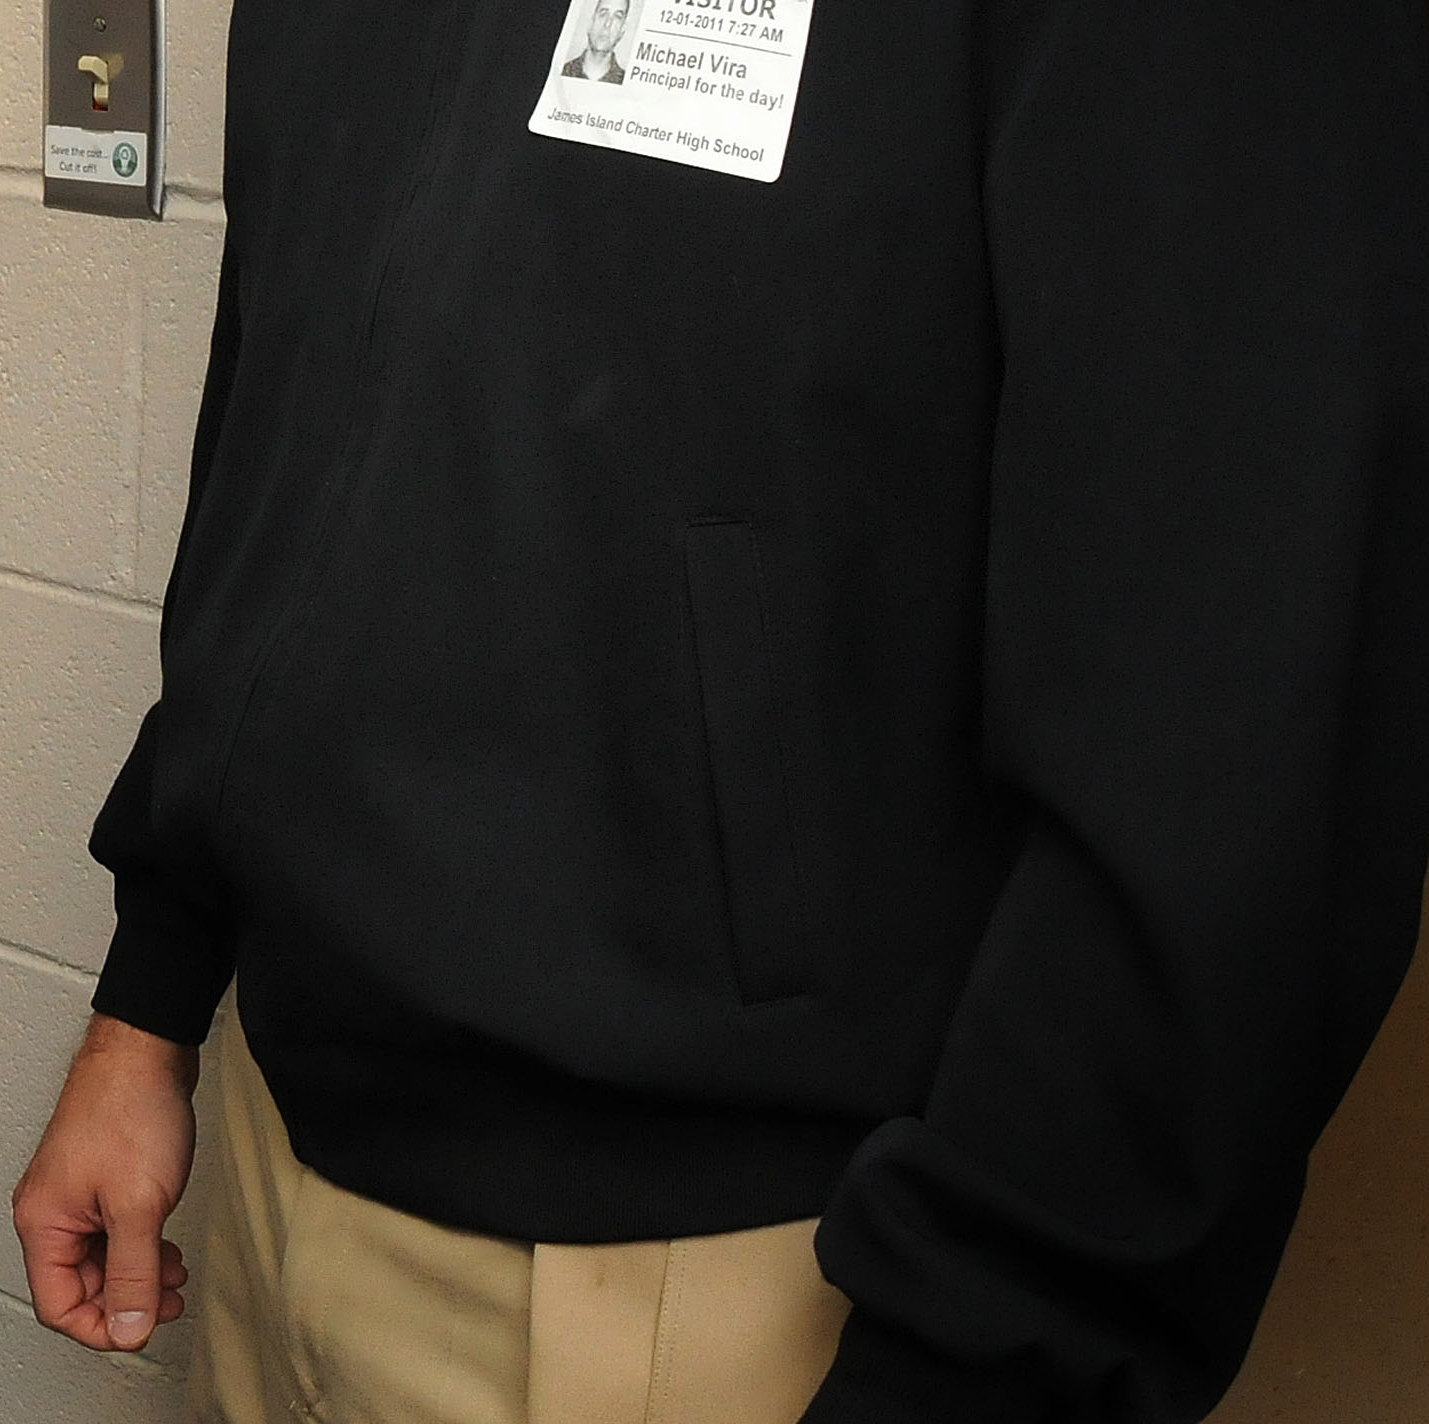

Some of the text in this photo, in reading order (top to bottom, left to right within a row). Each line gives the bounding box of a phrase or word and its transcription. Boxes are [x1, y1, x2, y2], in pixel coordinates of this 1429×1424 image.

[660, 9, 784, 43] 12-01-2011 7:27 AM
[635, 41, 747, 79] Michael Vira
[630, 65, 785, 112] Principal for the day!
[50, 144, 70, 155] Save
[71, 146, 85, 157] the
[547, 107, 765, 163] James Island Charter High School
[59, 161, 73, 172] Cut
[74, 162, 81, 173] it
